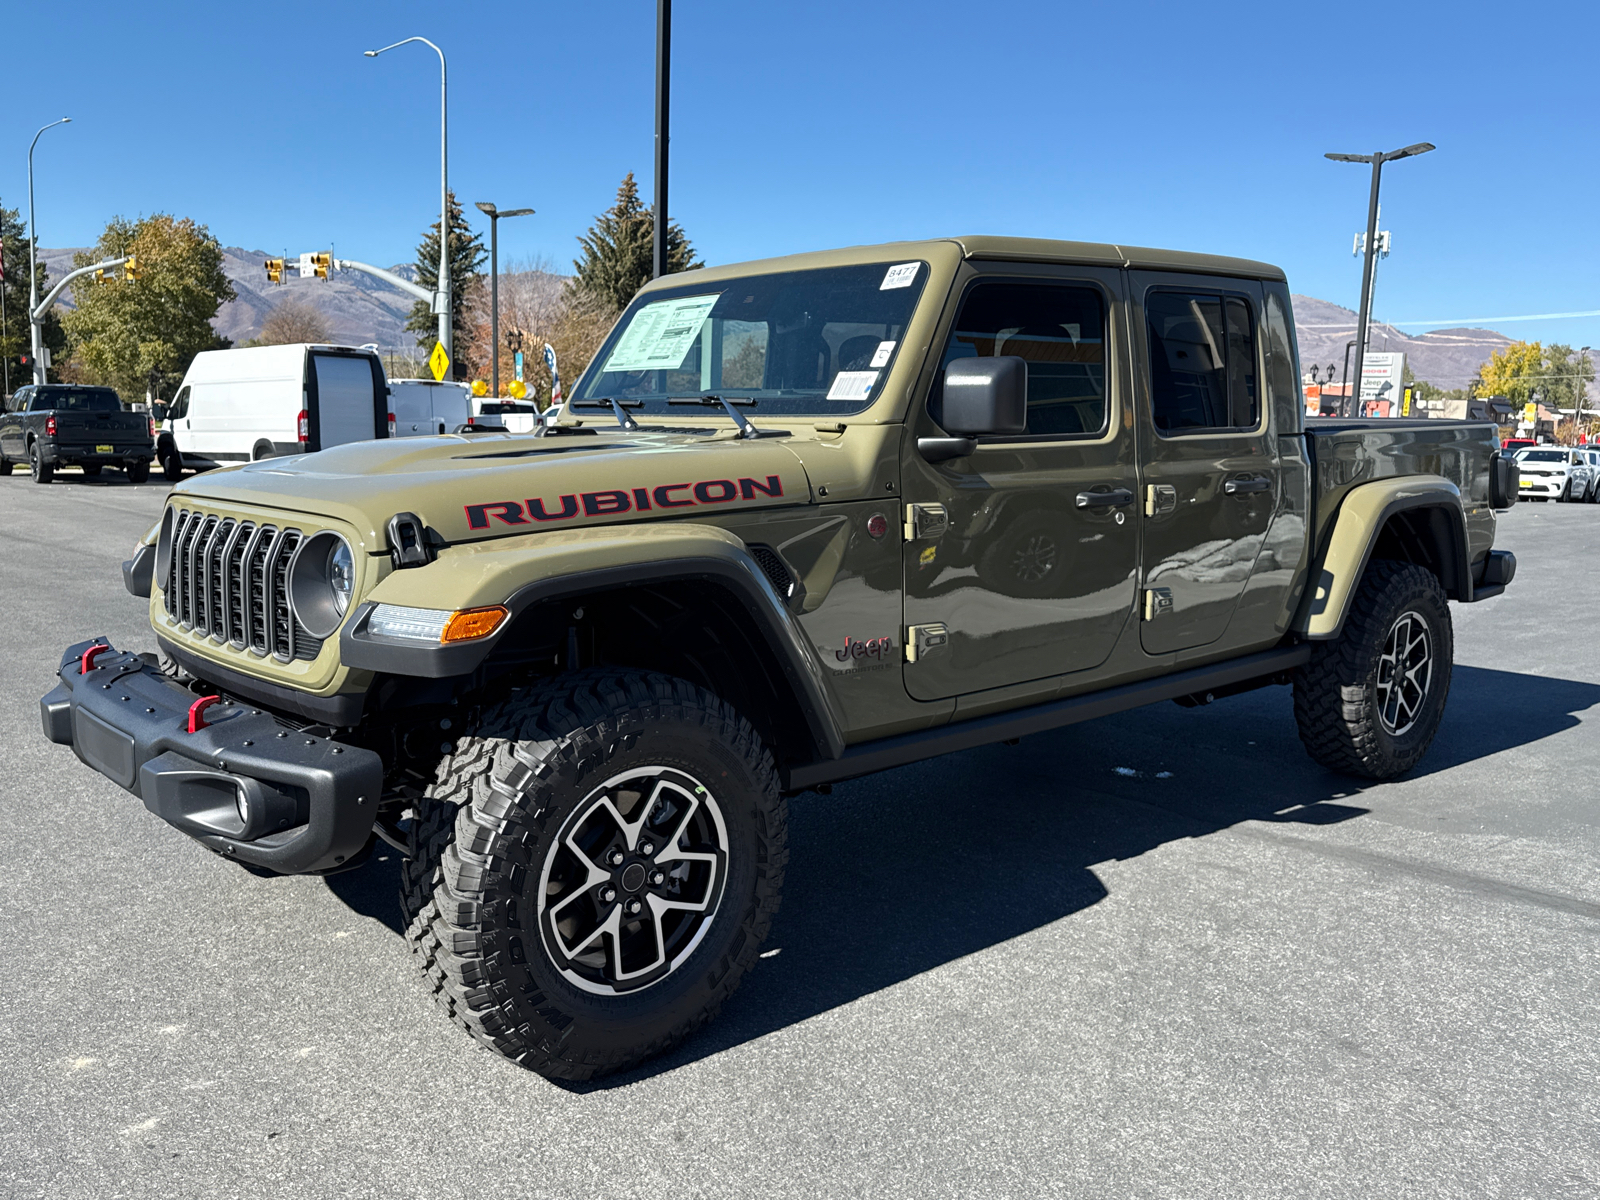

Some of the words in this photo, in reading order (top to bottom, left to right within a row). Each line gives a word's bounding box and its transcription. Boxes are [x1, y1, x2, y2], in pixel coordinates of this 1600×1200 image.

[889, 266, 917, 278] 8477
[463, 474, 785, 531] RUBICON
[835, 635, 893, 662] Jeep
[832, 664, 885, 677] GLADIATOR
